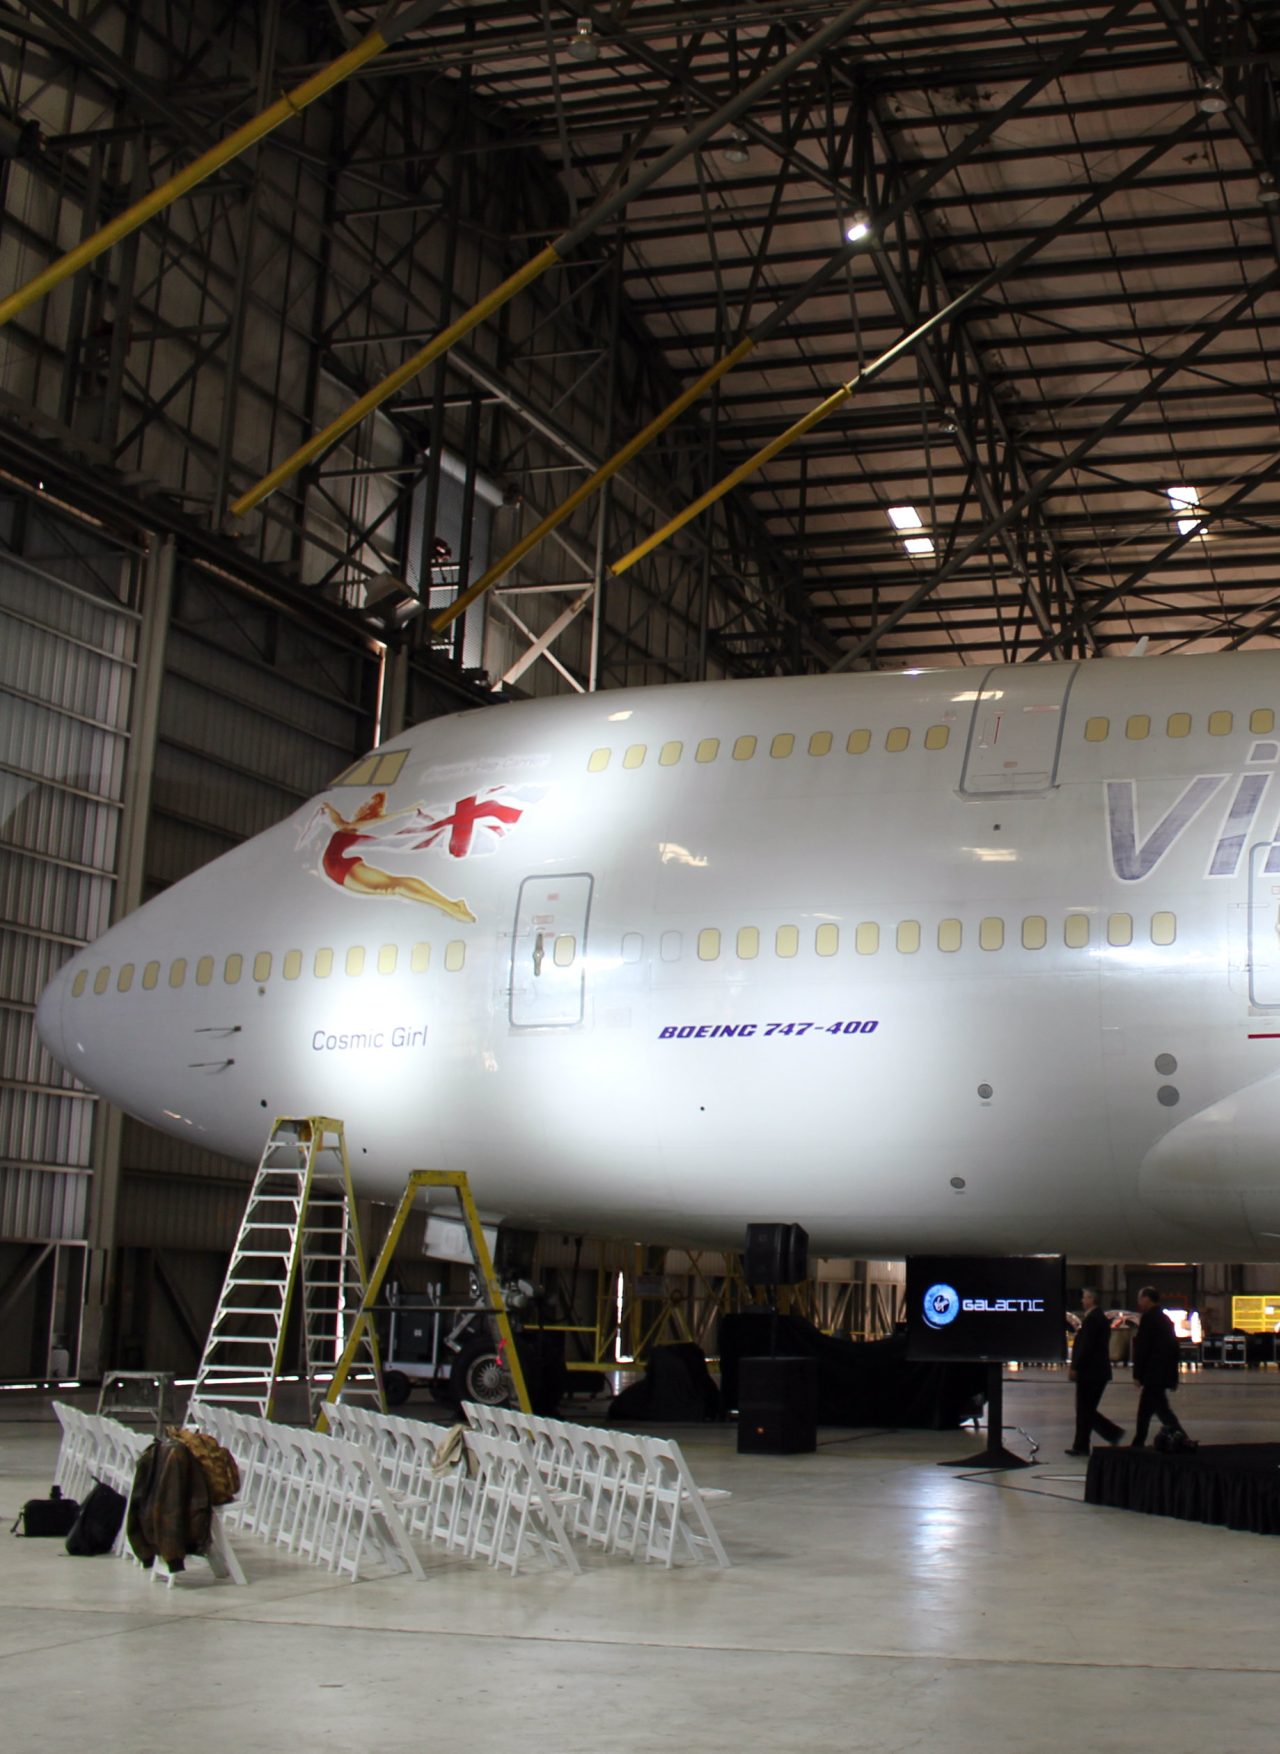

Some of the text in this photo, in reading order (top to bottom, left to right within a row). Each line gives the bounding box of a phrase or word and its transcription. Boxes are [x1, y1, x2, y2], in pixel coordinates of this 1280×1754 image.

[312, 1025, 428, 1051] Cosmic Girl
[658, 1020, 879, 1039] BOEING 747-400
[962, 1299, 1045, 1312] GALACTIC
